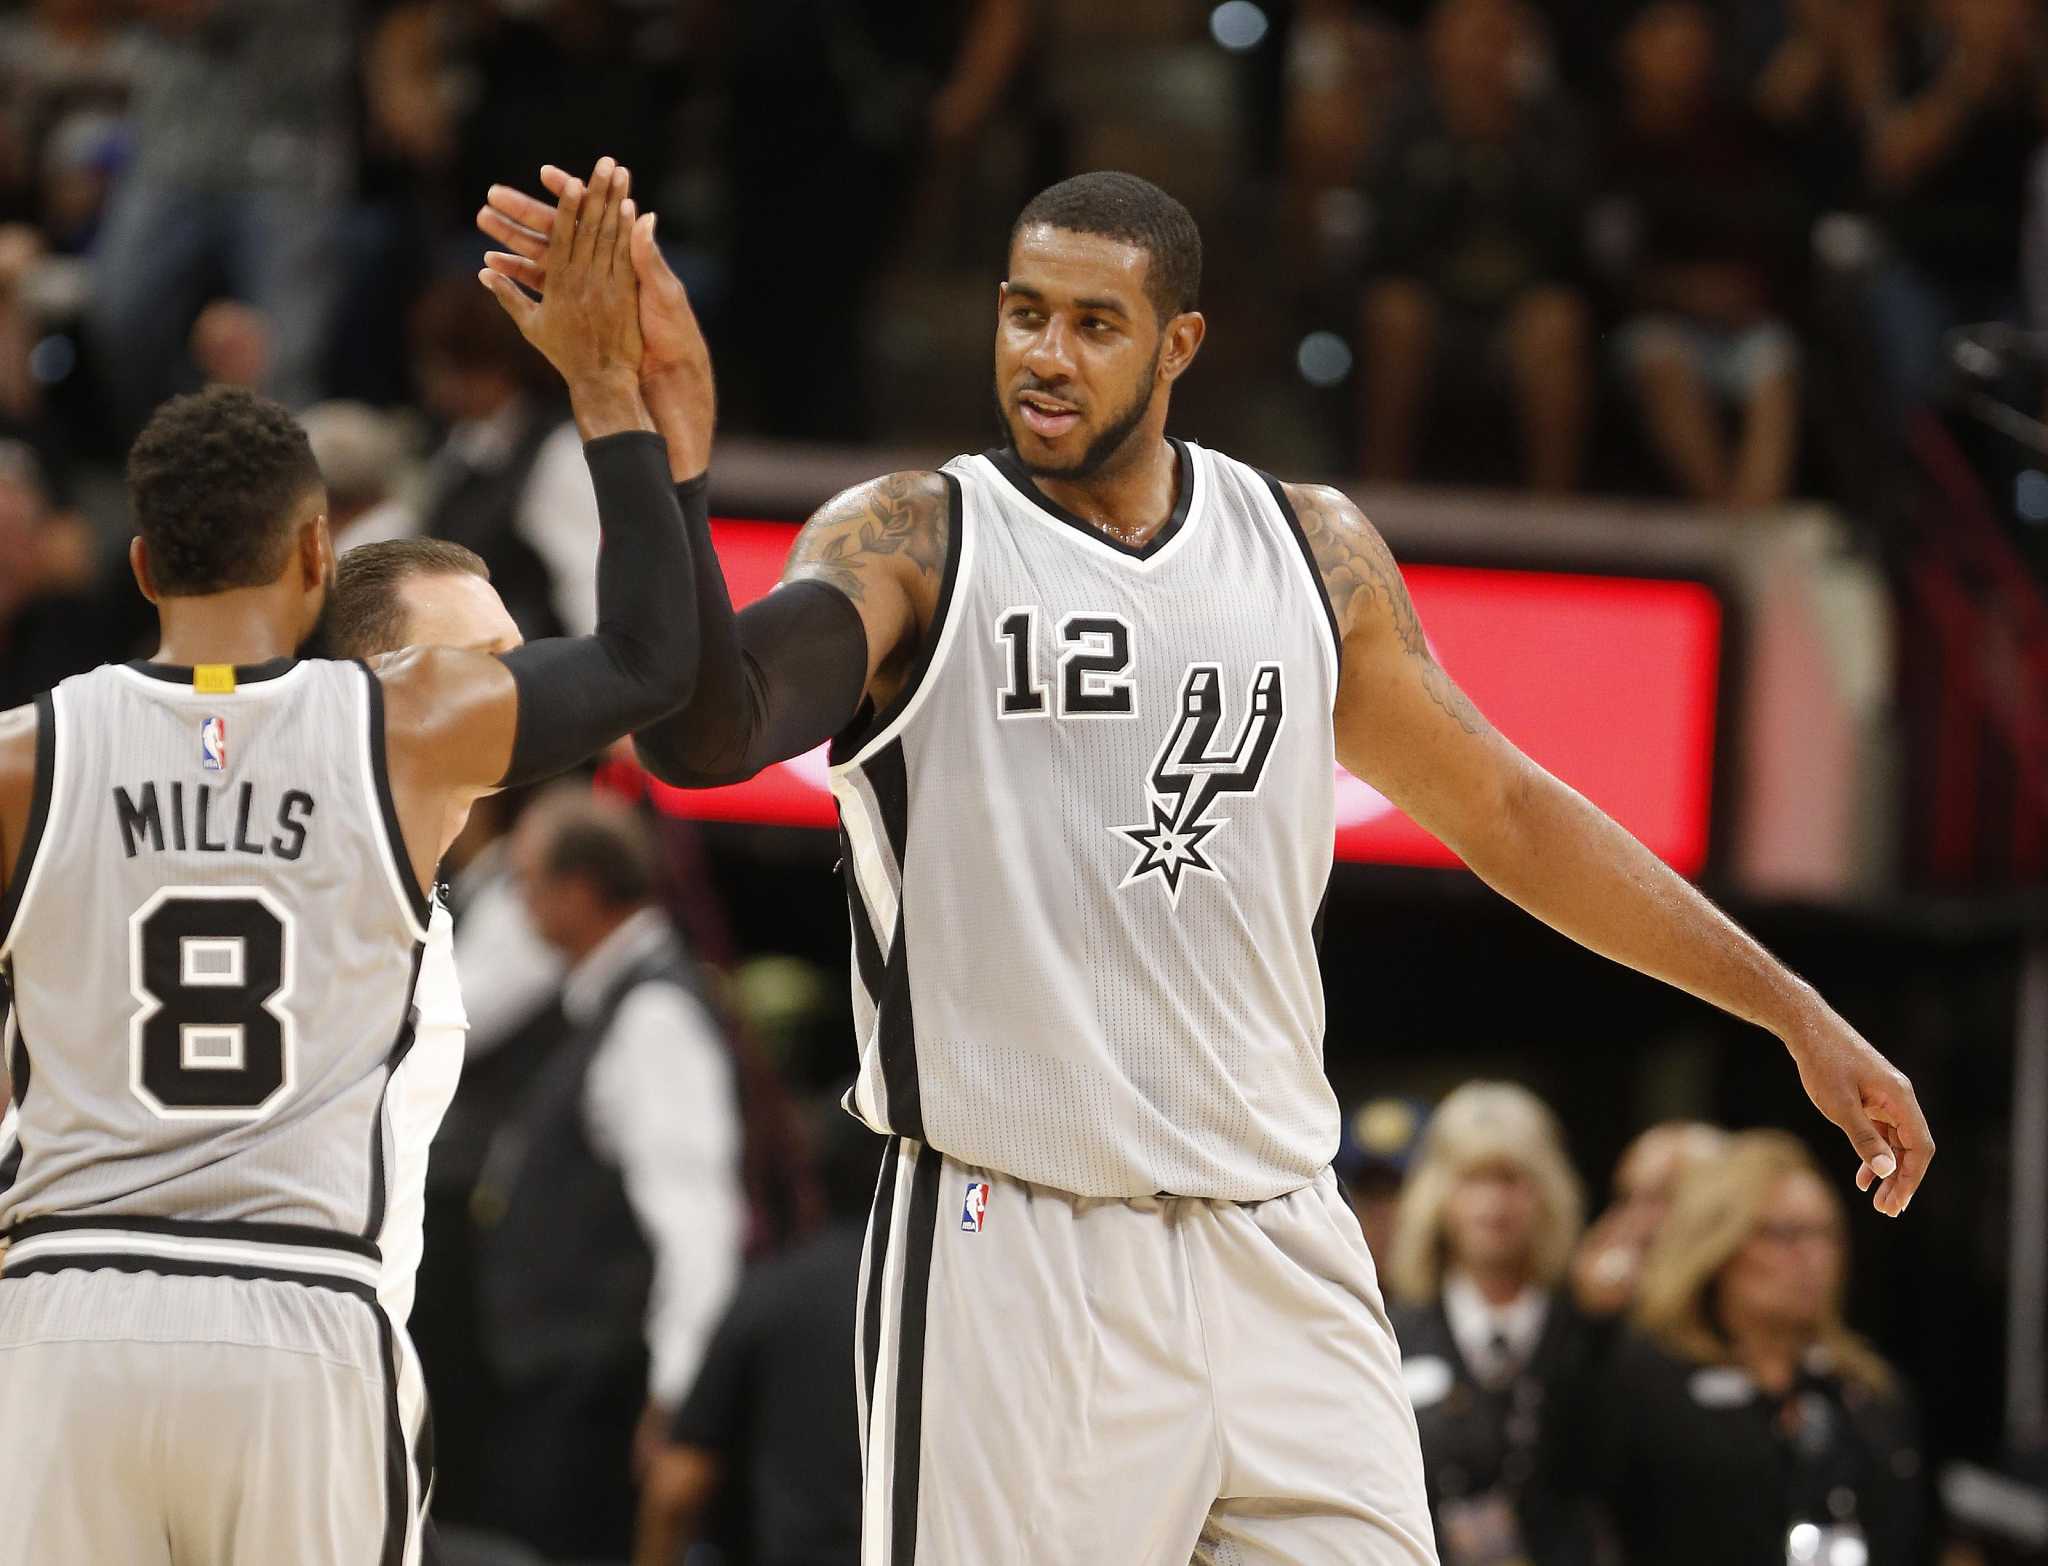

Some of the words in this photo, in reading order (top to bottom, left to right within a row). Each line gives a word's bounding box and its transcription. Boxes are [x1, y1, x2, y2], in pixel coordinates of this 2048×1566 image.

[995, 605, 1138, 719] 12
[112, 780, 316, 861] MILLS
[129, 886, 295, 1120] 8
